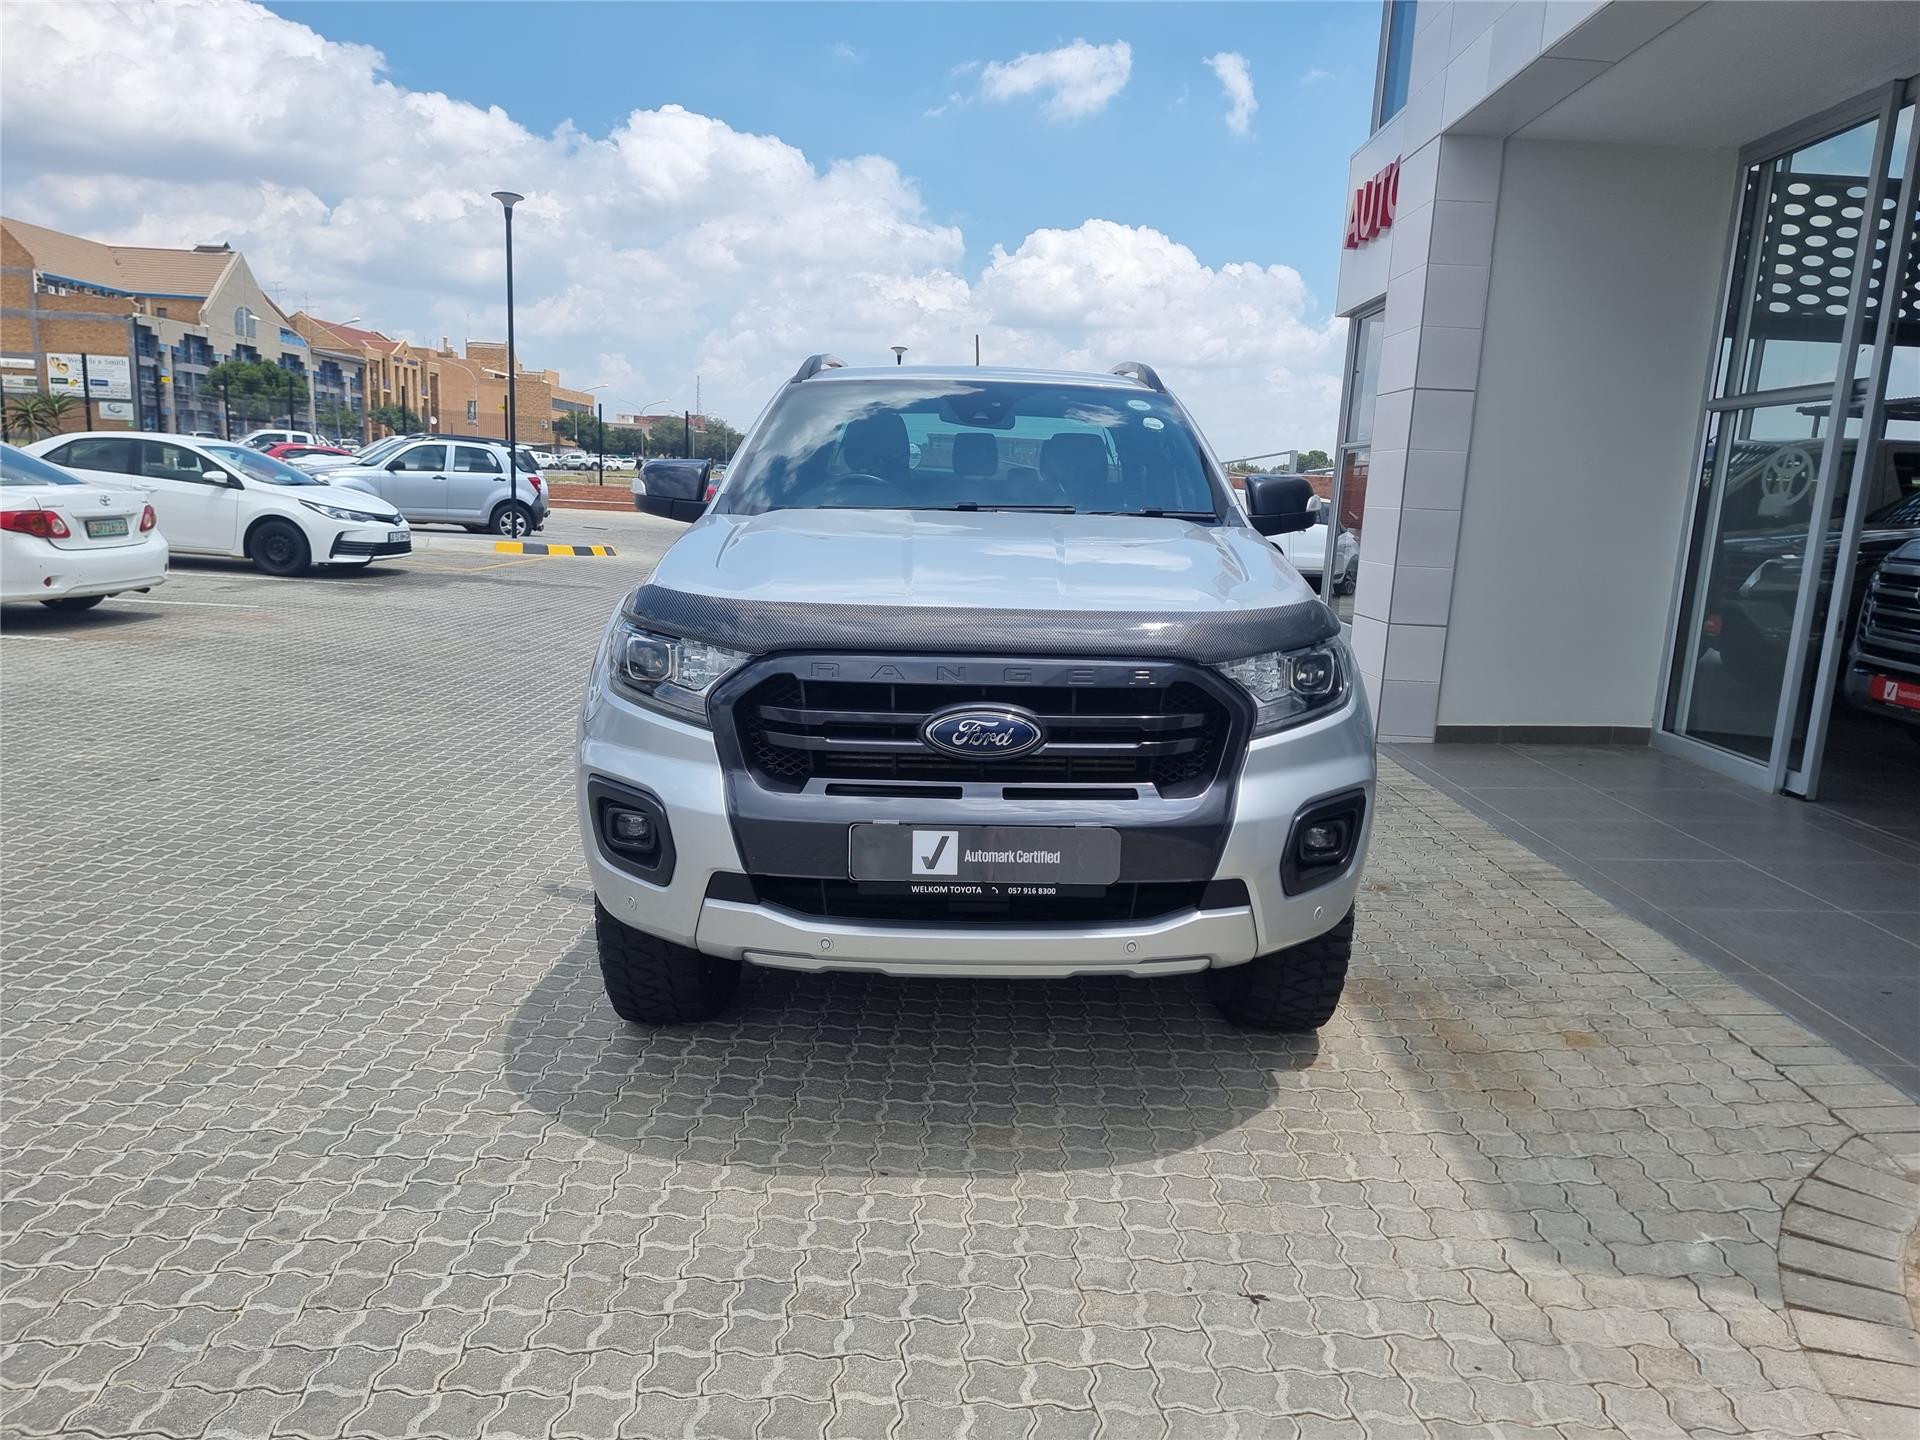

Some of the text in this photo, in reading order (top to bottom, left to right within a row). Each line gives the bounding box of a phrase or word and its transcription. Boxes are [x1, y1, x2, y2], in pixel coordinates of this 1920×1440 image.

[809, 661, 1158, 686] RANGER
[952, 719, 1014, 747] Ford
[964, 849, 1061, 864] Automark Certified
[911, 885, 982, 894] WELKOM TOYOTA
[1007, 887, 1056, 895] 057 916 8300
